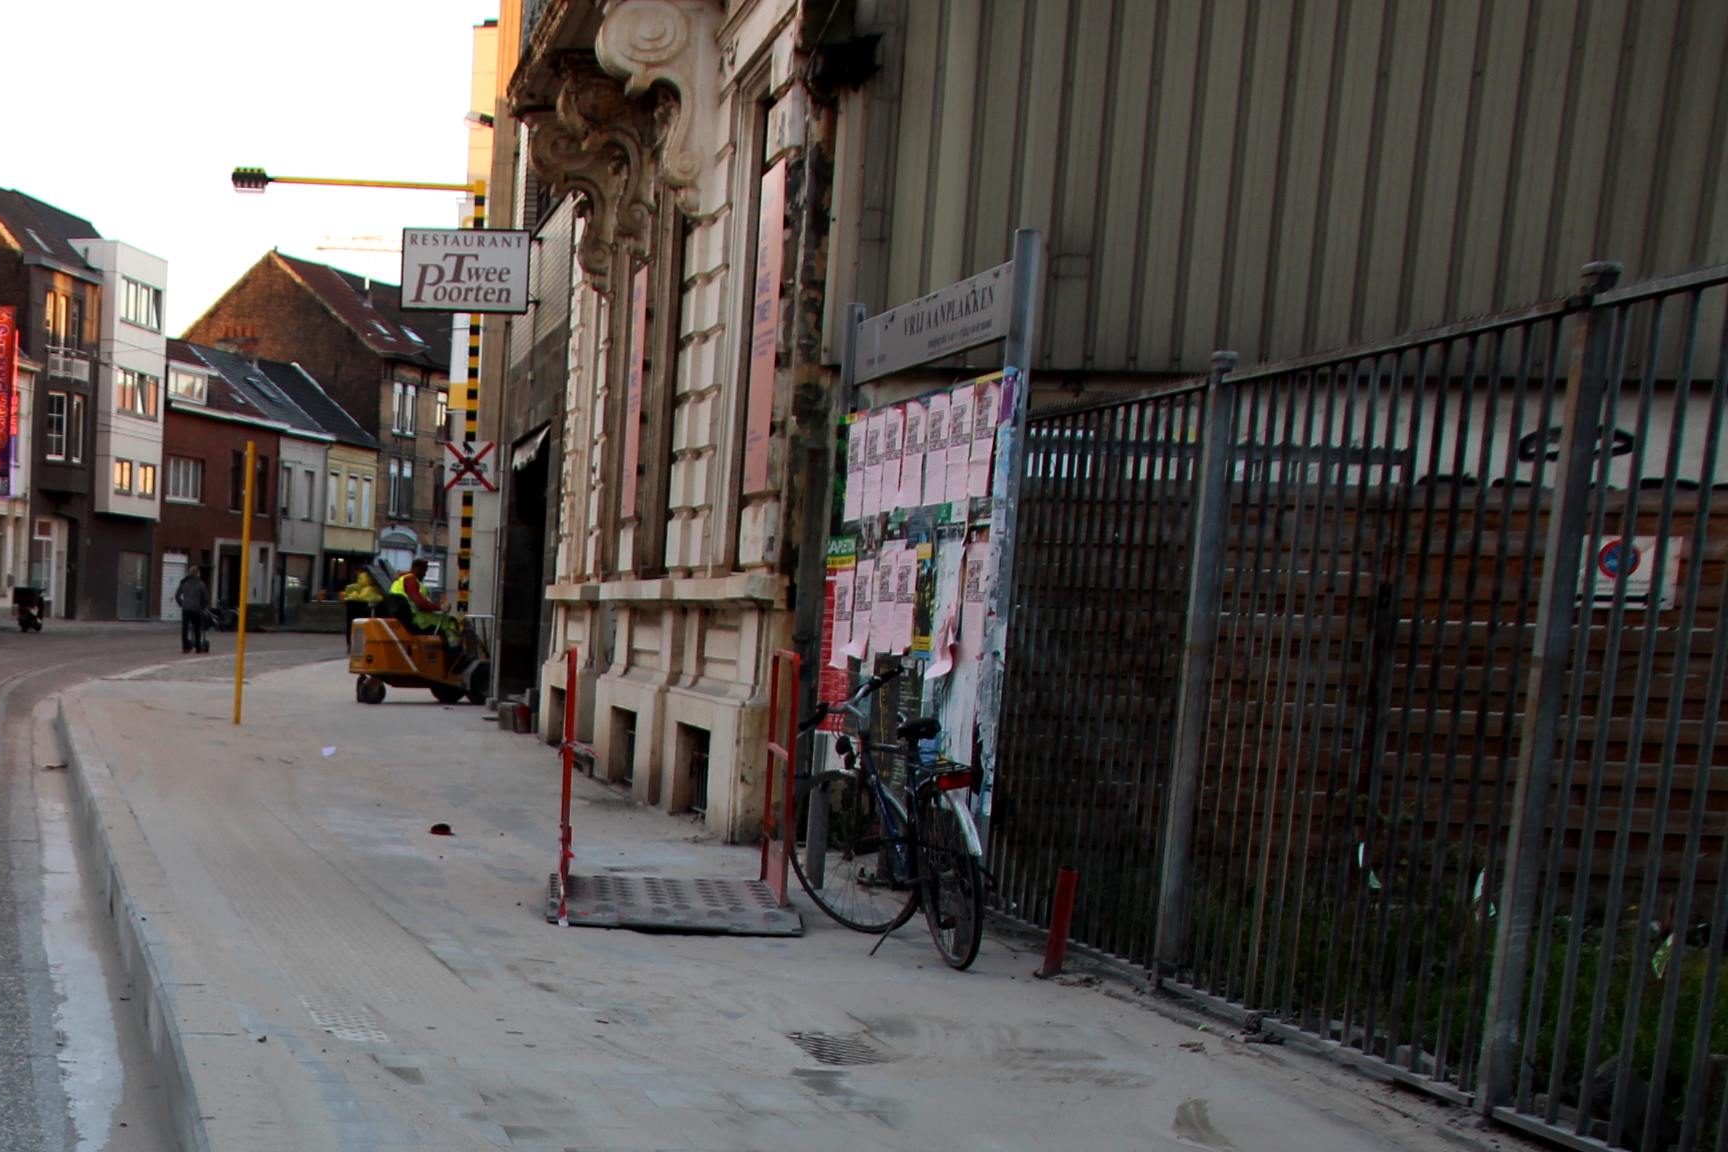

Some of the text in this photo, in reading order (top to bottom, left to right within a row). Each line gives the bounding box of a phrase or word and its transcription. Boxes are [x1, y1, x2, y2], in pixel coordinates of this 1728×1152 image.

[410, 233, 524, 248] RESTAURANT
[441, 252, 511, 284] Twee
[410, 263, 512, 303] Poorten
[904, 310, 924, 336] VRIJ
